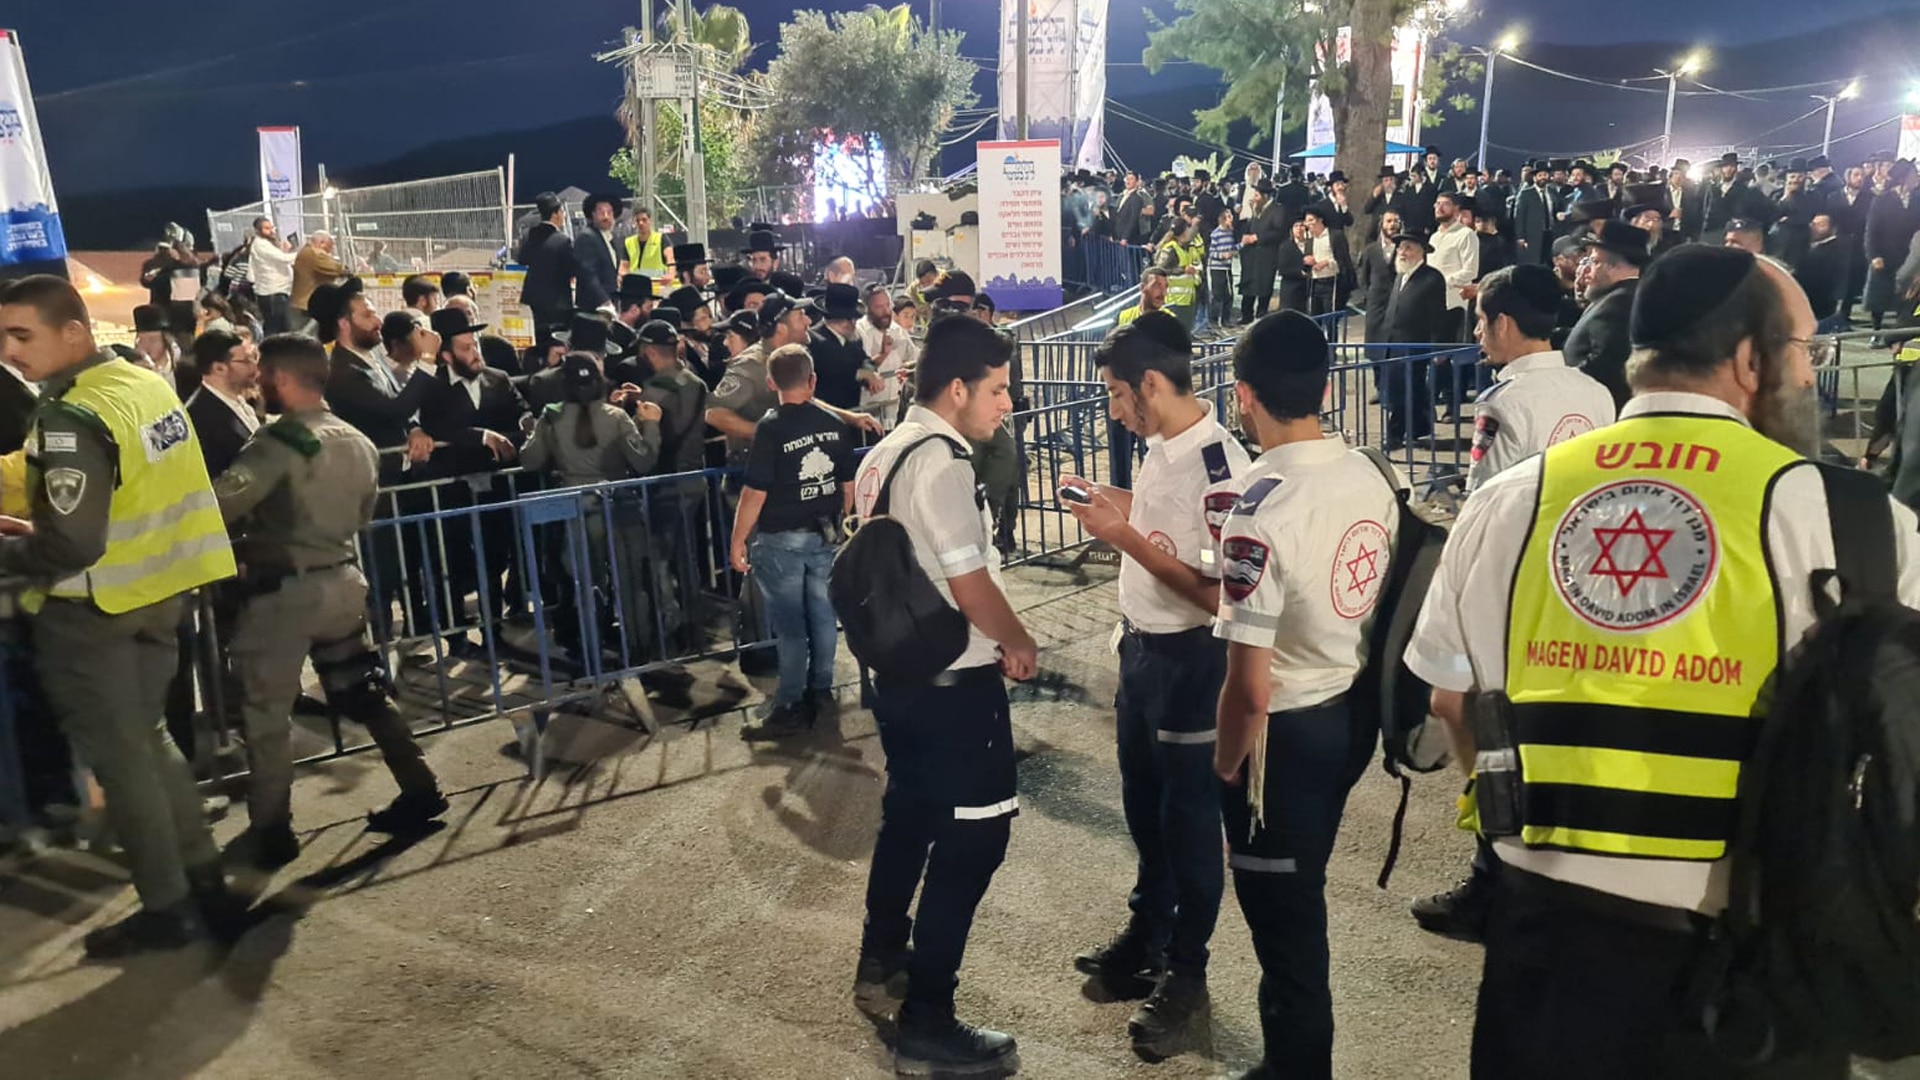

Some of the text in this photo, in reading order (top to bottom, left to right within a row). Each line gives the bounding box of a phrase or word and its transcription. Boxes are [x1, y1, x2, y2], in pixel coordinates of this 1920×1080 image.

[1595, 441, 1721, 473] חובש
[1562, 485, 1707, 542] מגן דוד אדום בישראל
[1580, 597, 1614, 621] DAVID
[1617, 608, 1658, 623] ADOM
[1659, 600, 1675, 615] IN
[1675, 562, 1706, 604] ISRAEL
[1526, 640, 1742, 686] MAGEN DAVID ADOM
